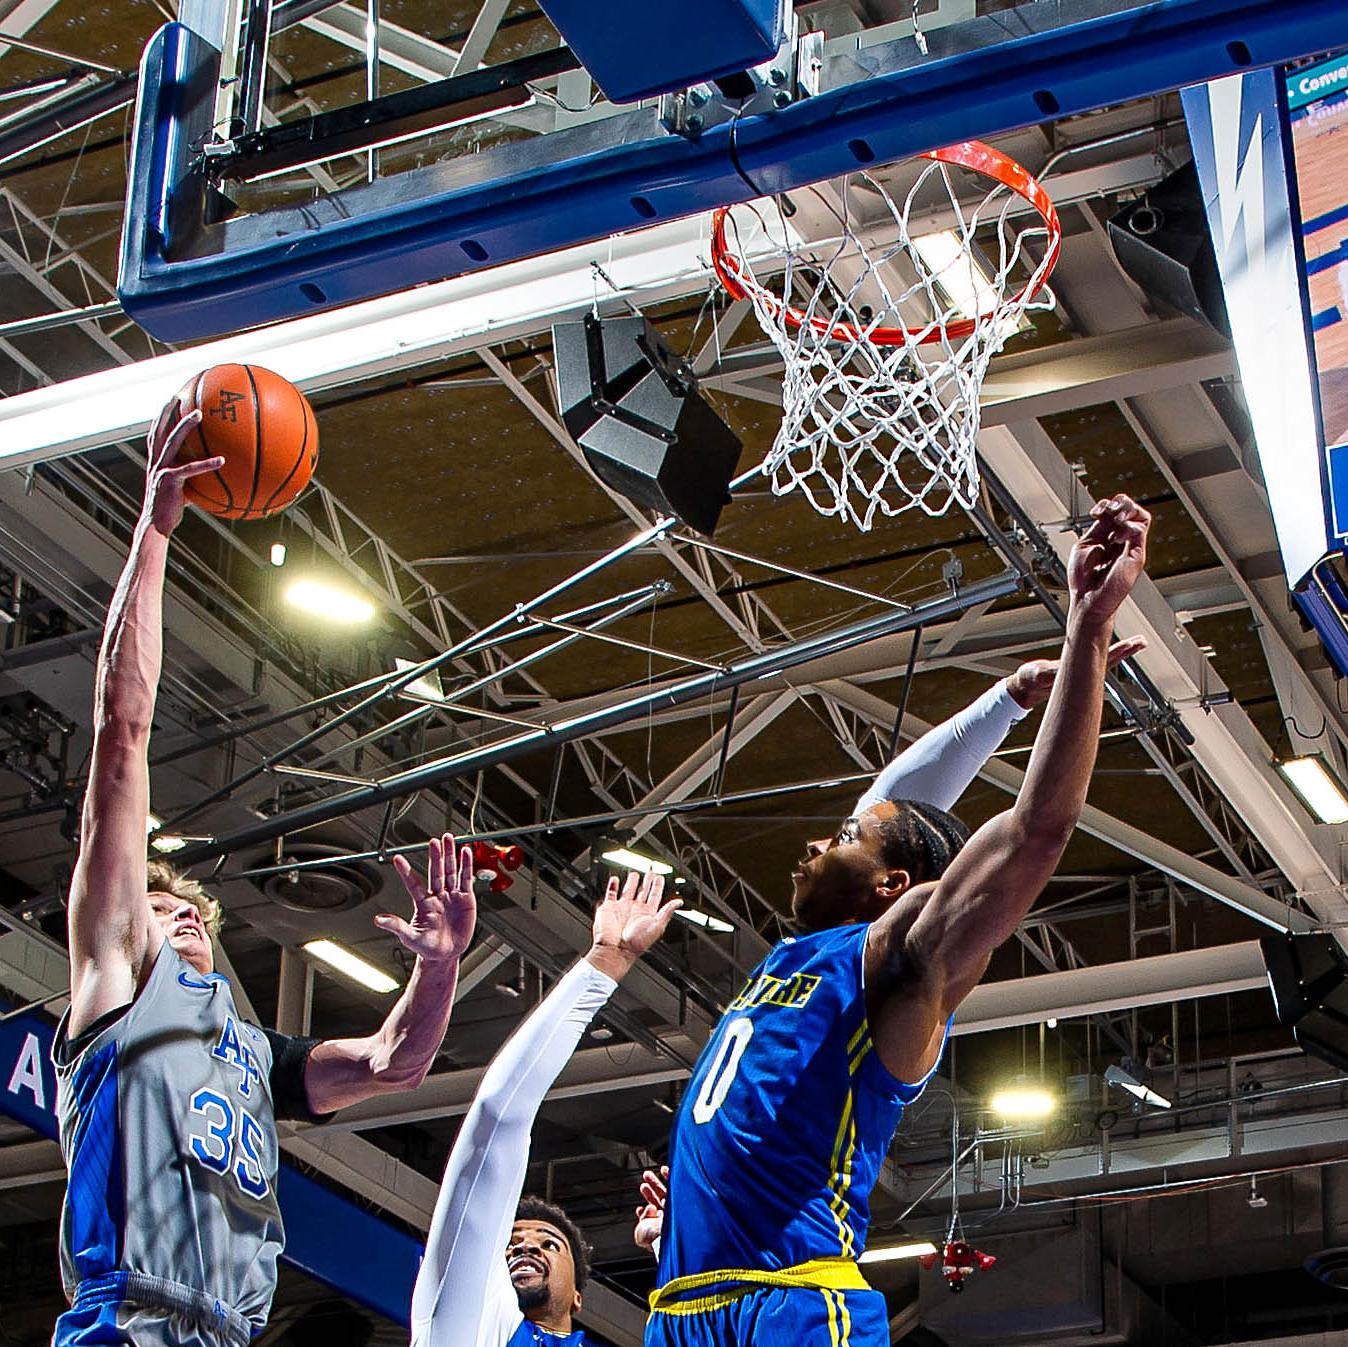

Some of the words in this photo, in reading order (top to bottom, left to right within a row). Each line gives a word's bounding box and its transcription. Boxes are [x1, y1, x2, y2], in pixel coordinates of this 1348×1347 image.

[212, 1015, 259, 1097] AF
[693, 1017, 754, 1124] 0
[188, 1086, 269, 1200] 35
